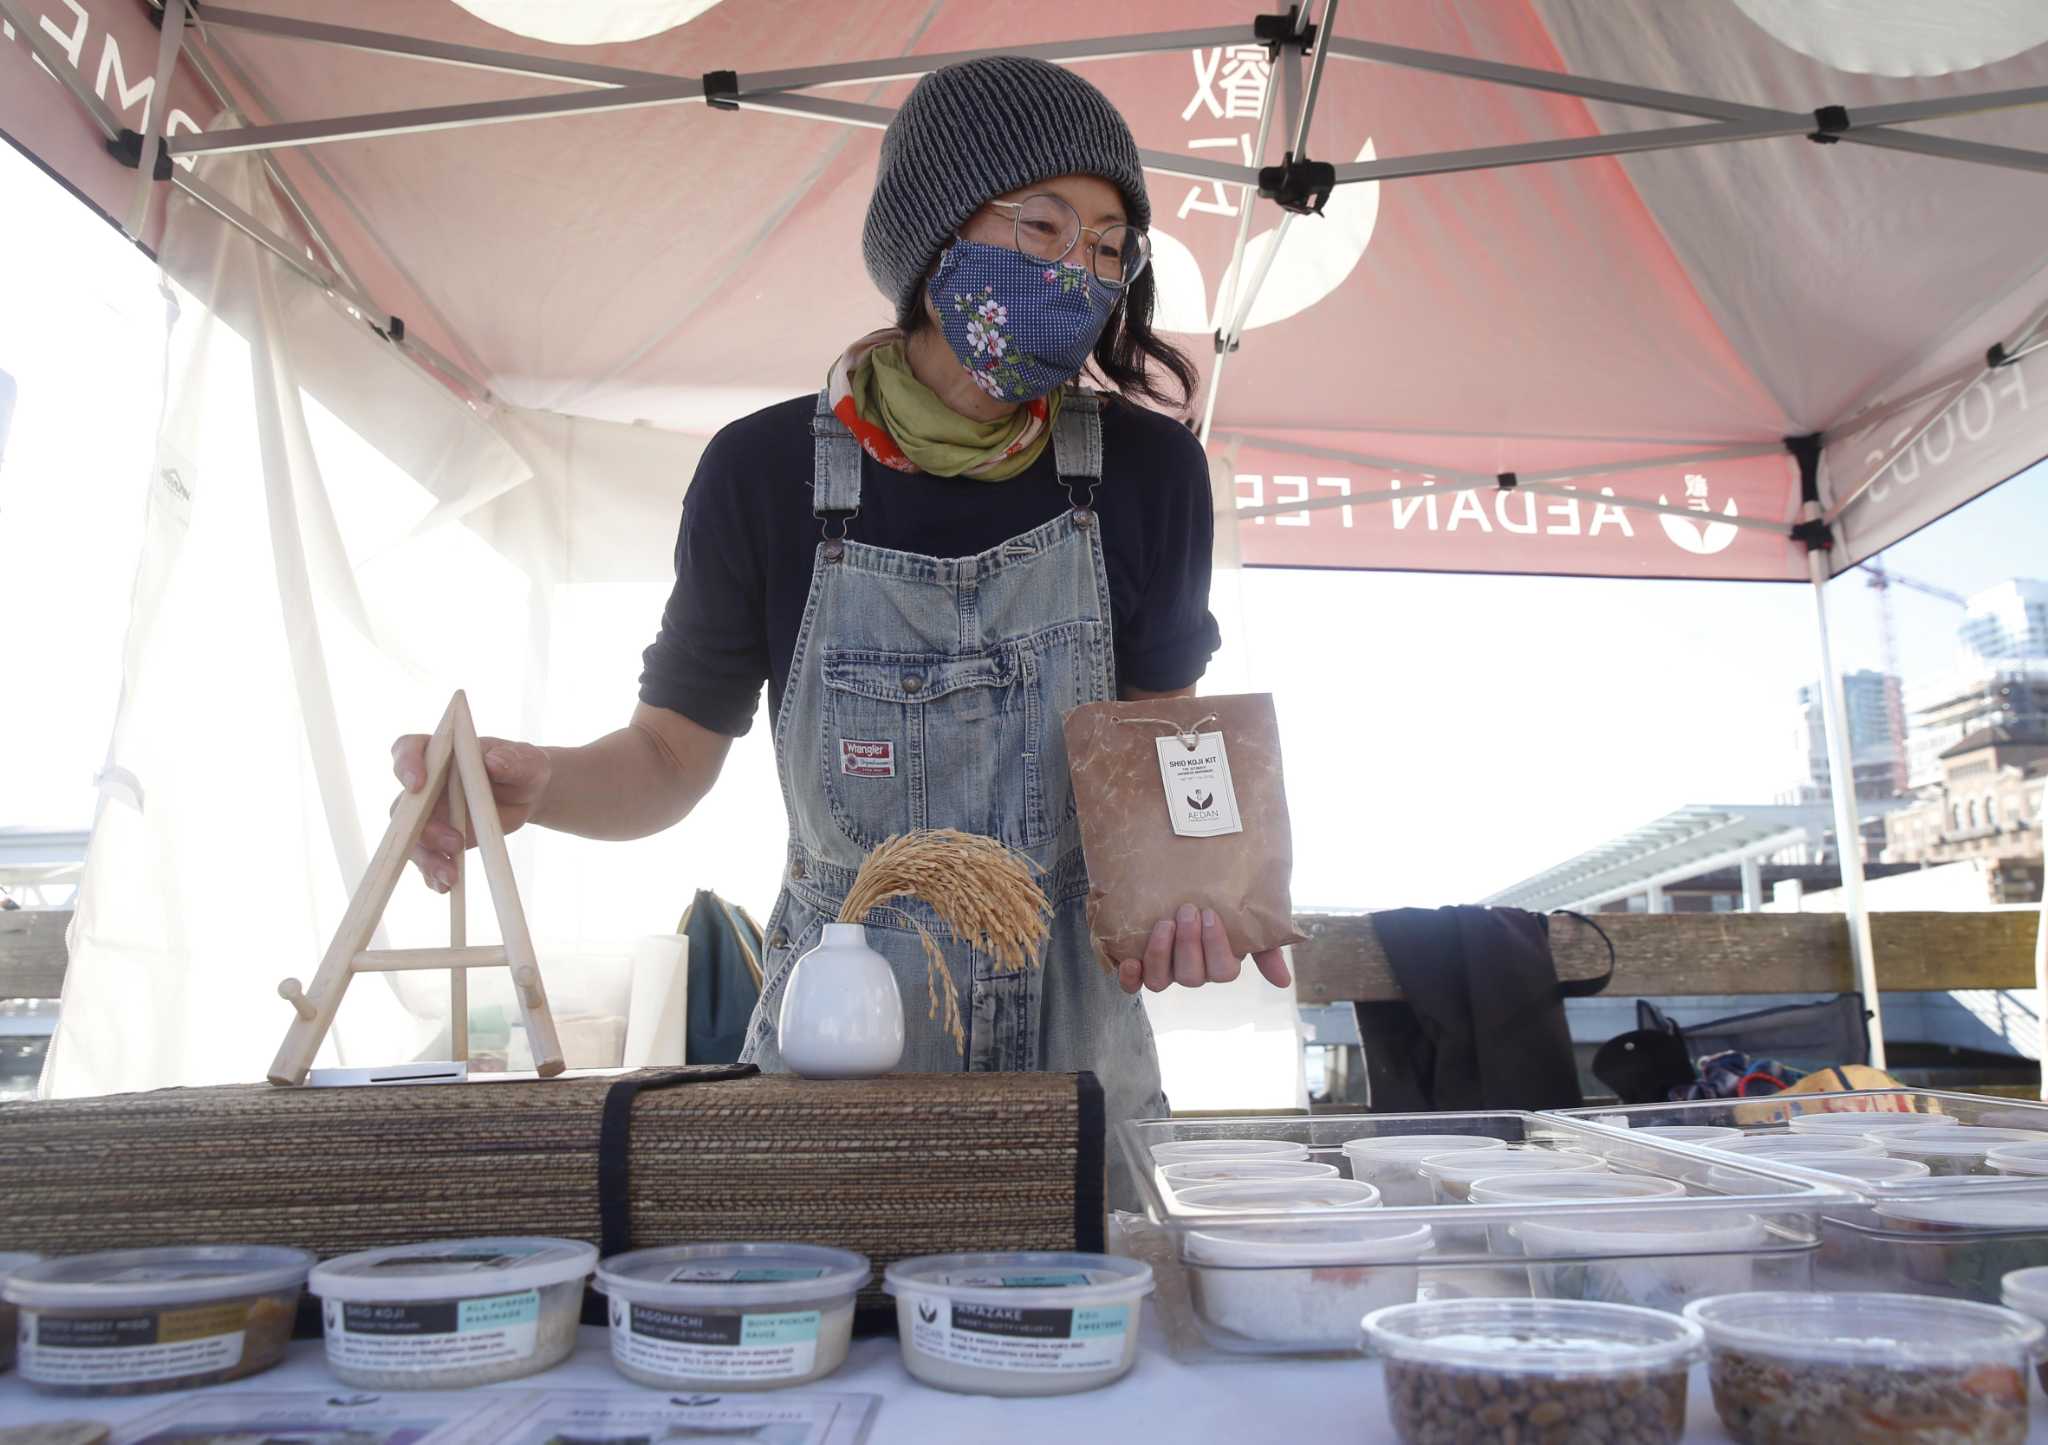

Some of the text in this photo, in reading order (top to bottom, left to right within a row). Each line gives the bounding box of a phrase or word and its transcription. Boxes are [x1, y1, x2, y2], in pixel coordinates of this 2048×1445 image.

[847, 743, 884, 757] Wrangler
[1169, 756, 1216, 768] SHIO KOJI KIT
[375, 1306, 405, 1319] KOJI
[957, 1304, 1023, 1321] AMAZAKE
